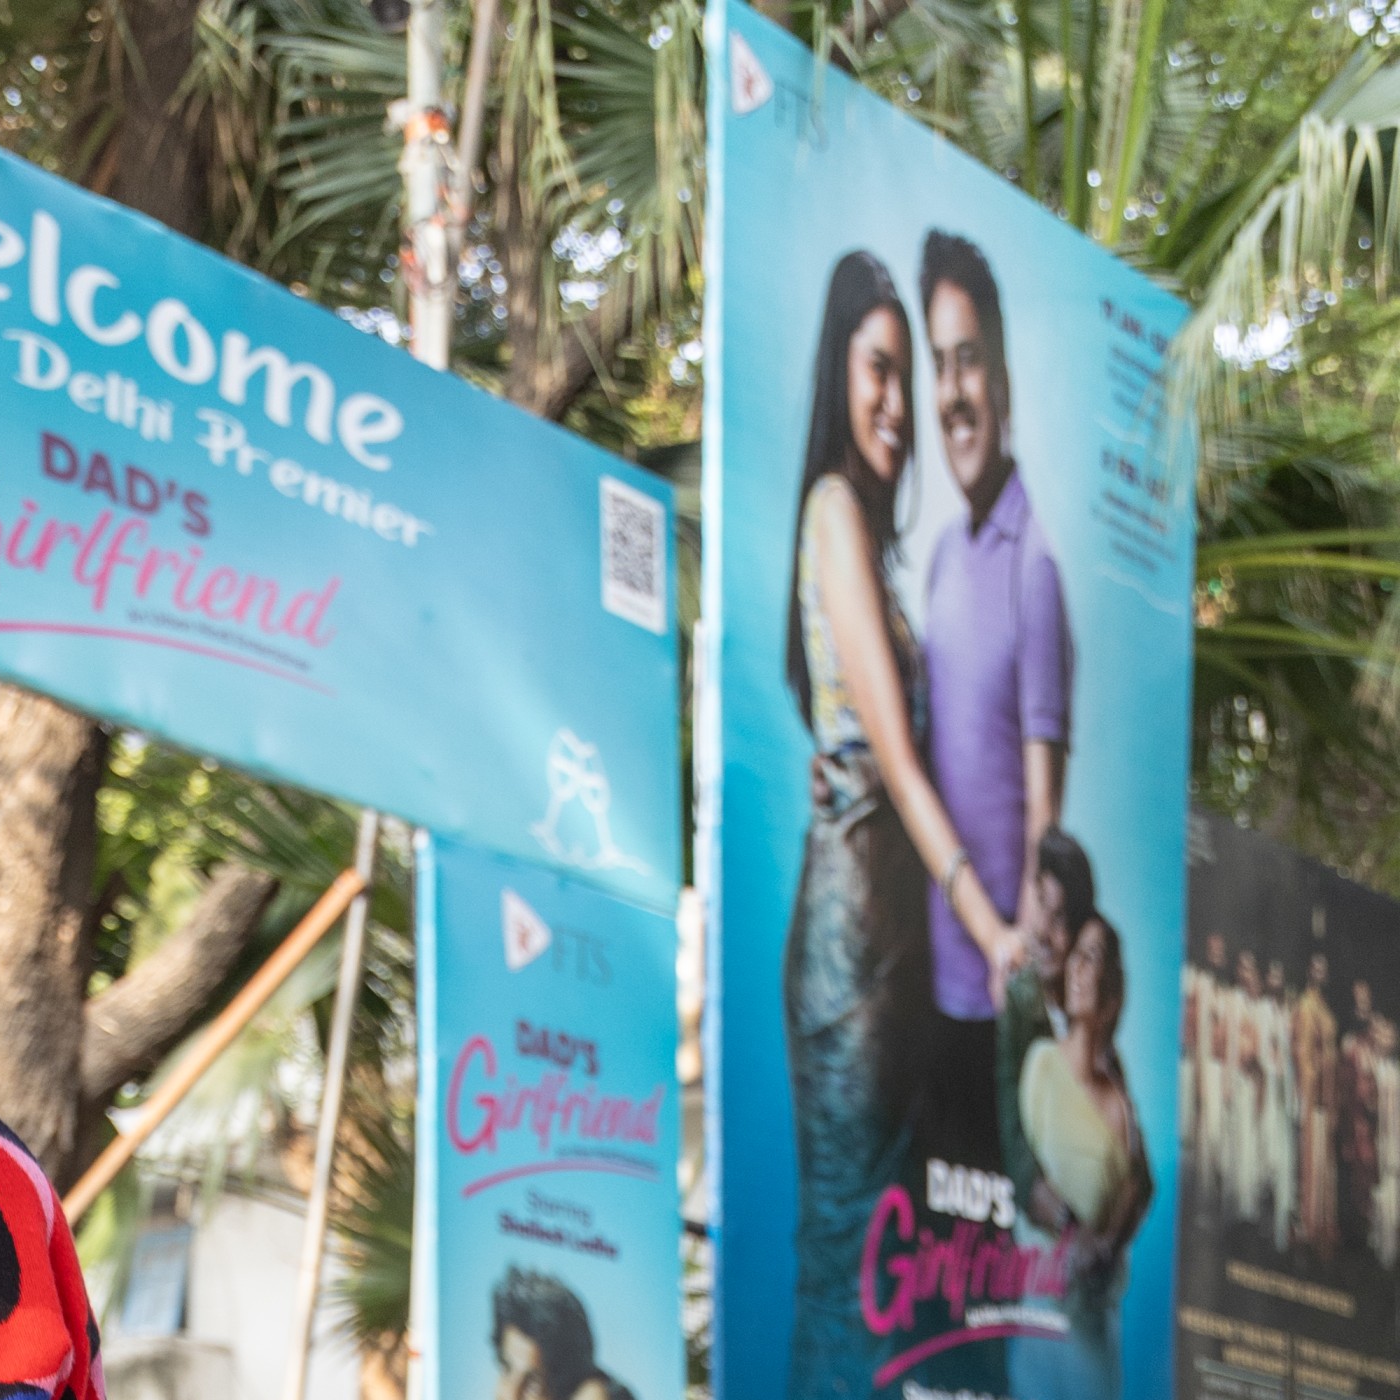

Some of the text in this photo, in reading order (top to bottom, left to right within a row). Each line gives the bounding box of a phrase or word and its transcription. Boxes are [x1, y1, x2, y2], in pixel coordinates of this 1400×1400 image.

[6, 328, 175, 444] Delhi
[197, 408, 436, 548] Premier
[40, 430, 213, 539] DAD'S
[446, 1034, 667, 1154] Girlfriend
[515, 1018, 598, 1076] DAD'S
[926, 1158, 1016, 1229] DAD'S
[860, 1184, 1076, 1337] Girlfriend
